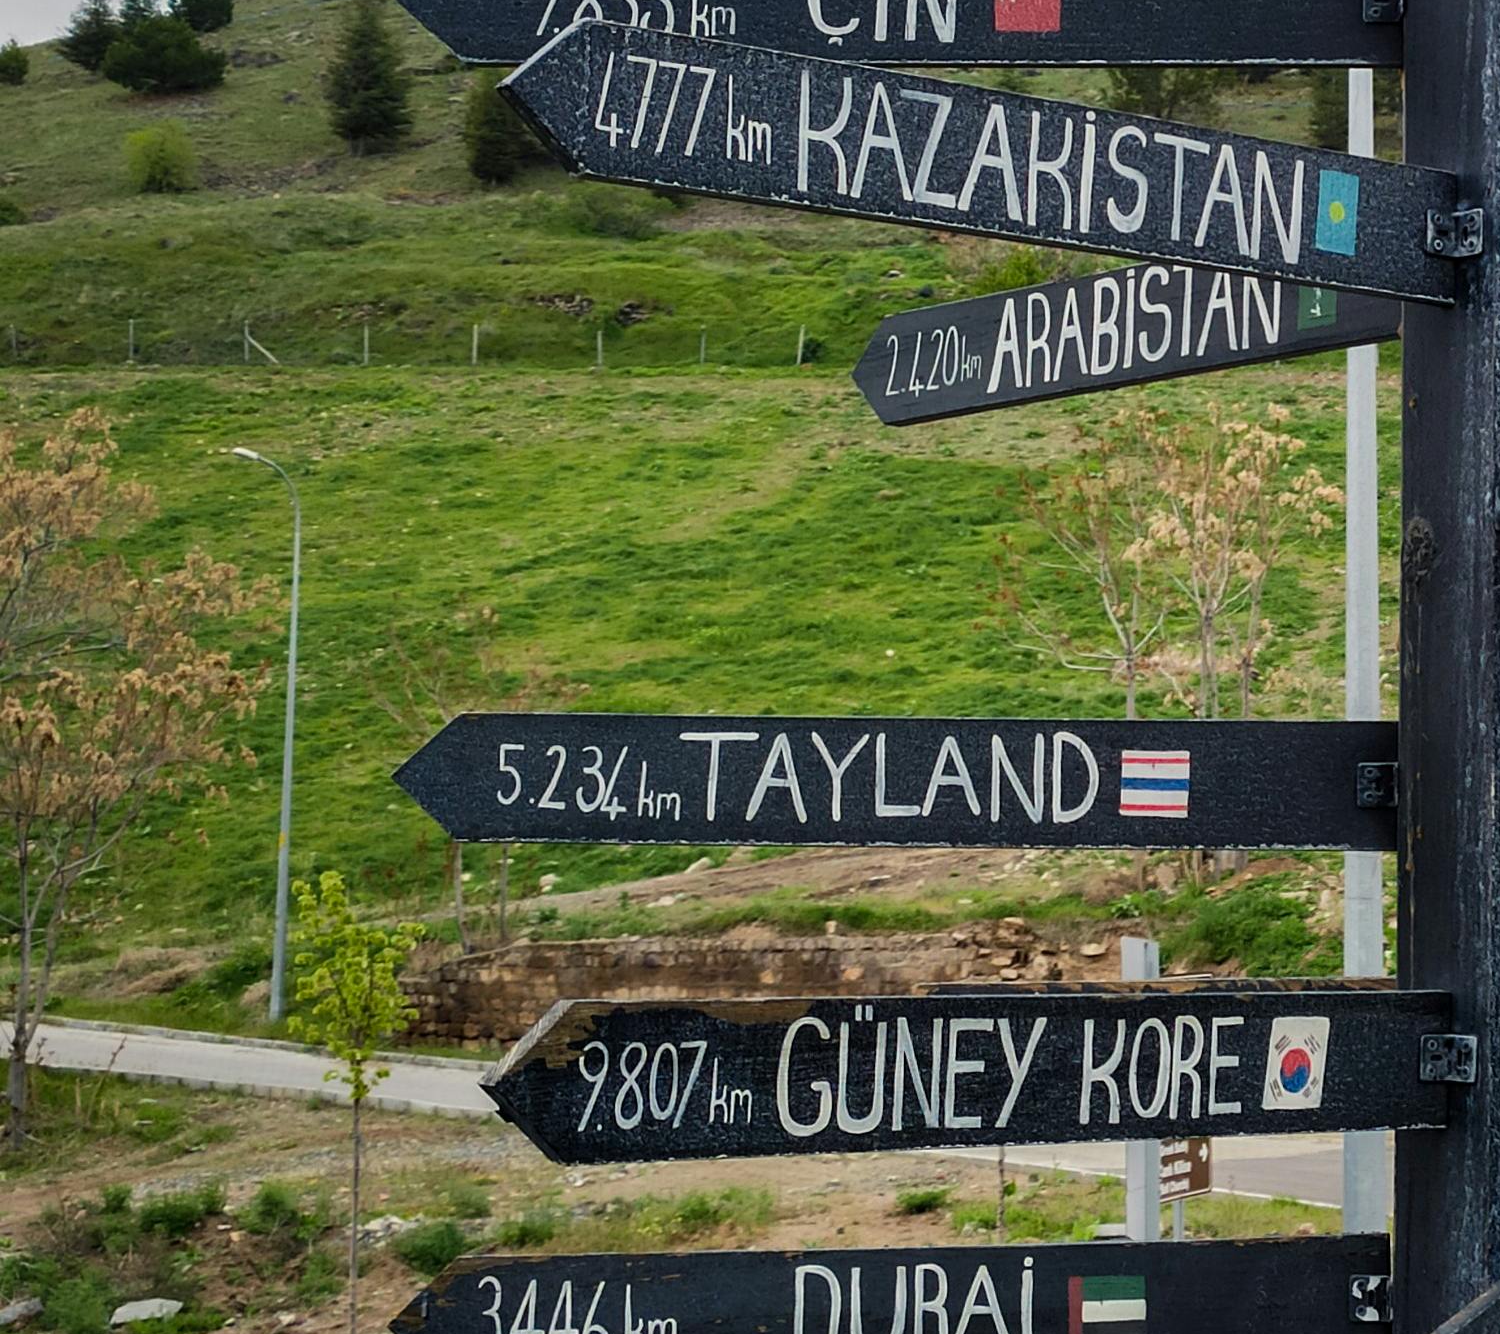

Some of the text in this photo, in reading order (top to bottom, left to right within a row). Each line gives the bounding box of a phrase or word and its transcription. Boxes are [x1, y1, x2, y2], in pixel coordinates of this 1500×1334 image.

[726, 74, 772, 165] km
[798, 69, 1305, 264] KAZAKİSTAN
[885, 325, 960, 398] 2.420
[960, 335, 982, 382] km
[986, 266, 1282, 394] ARABİSTAN
[497, 731, 1099, 824] 5.234 km TAYLAND
[578, 1004, 1243, 1137] 9.807 km GÜNEY KORE
